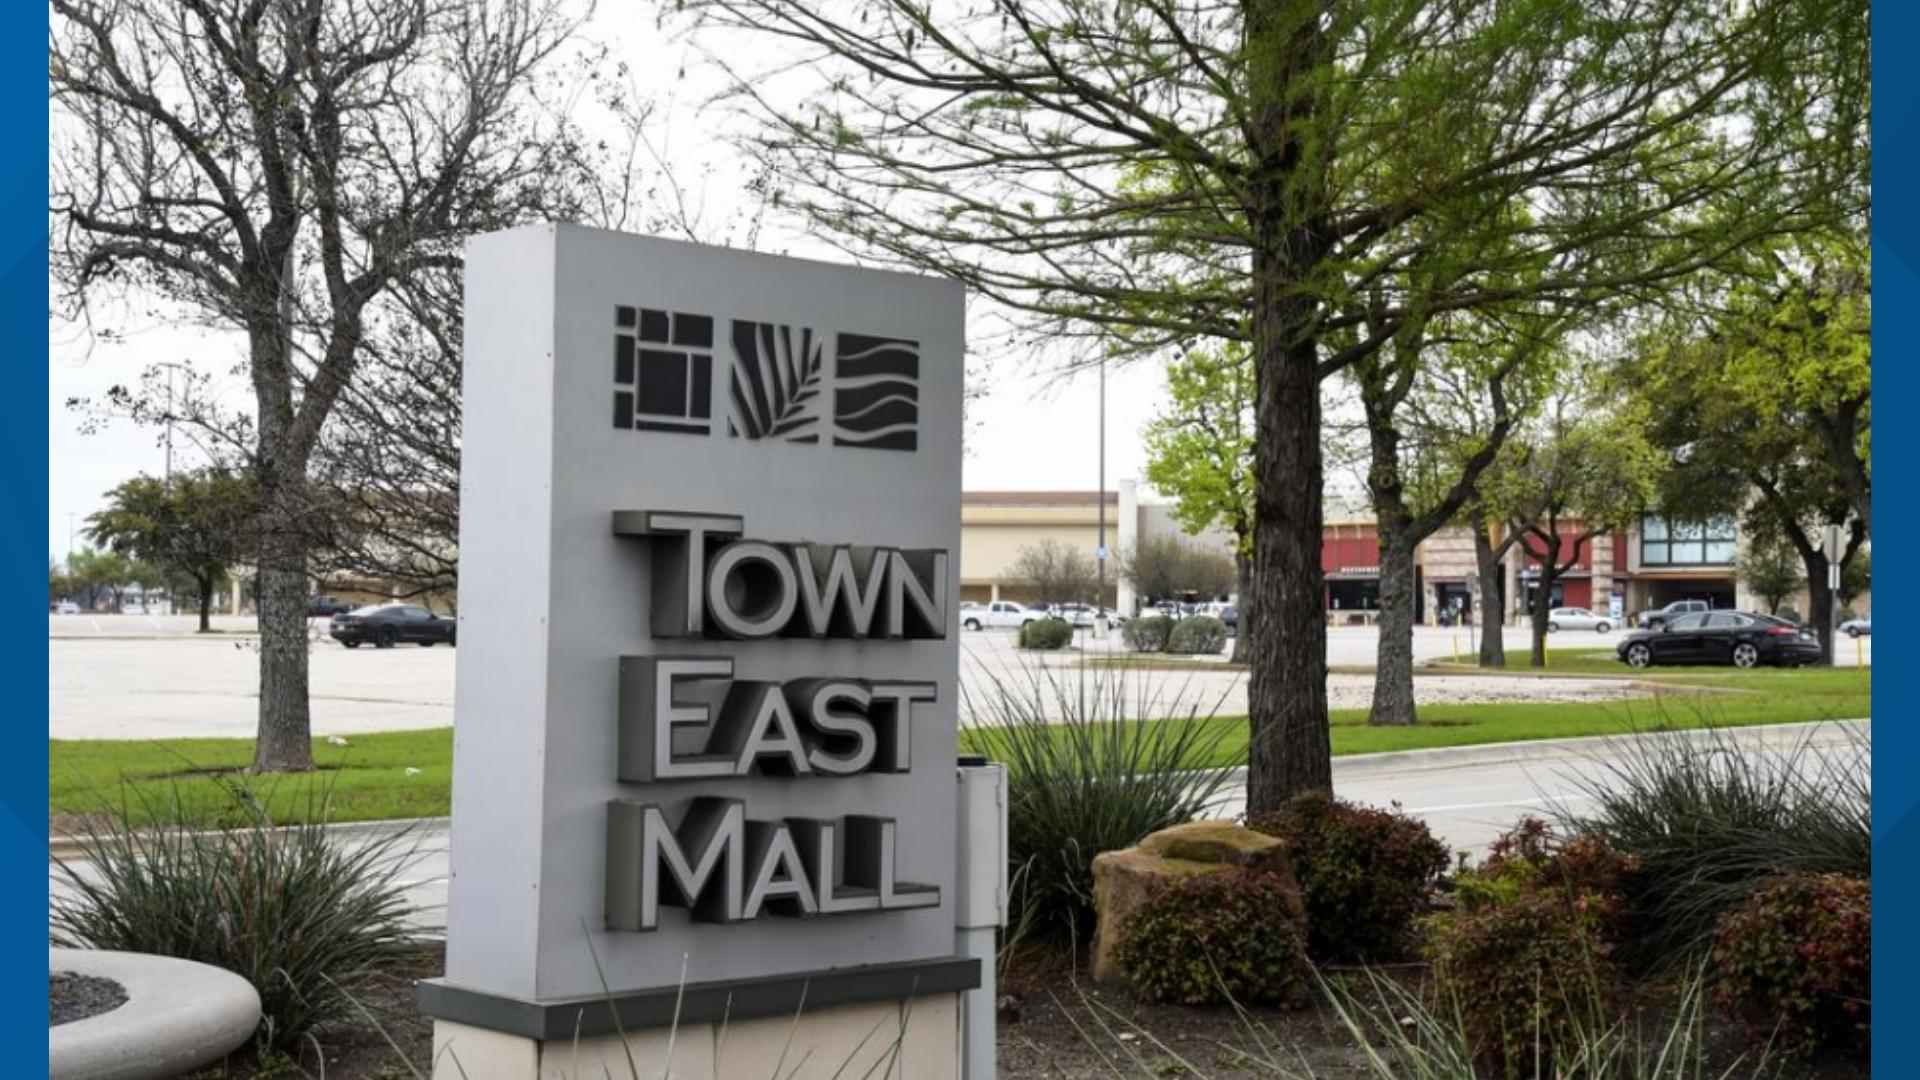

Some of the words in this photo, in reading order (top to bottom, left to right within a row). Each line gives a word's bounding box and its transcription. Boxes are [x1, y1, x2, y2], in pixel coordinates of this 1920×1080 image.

[648, 514, 947, 638] TOWN
[652, 657, 936, 780] EAST
[639, 799, 940, 930] MALL
